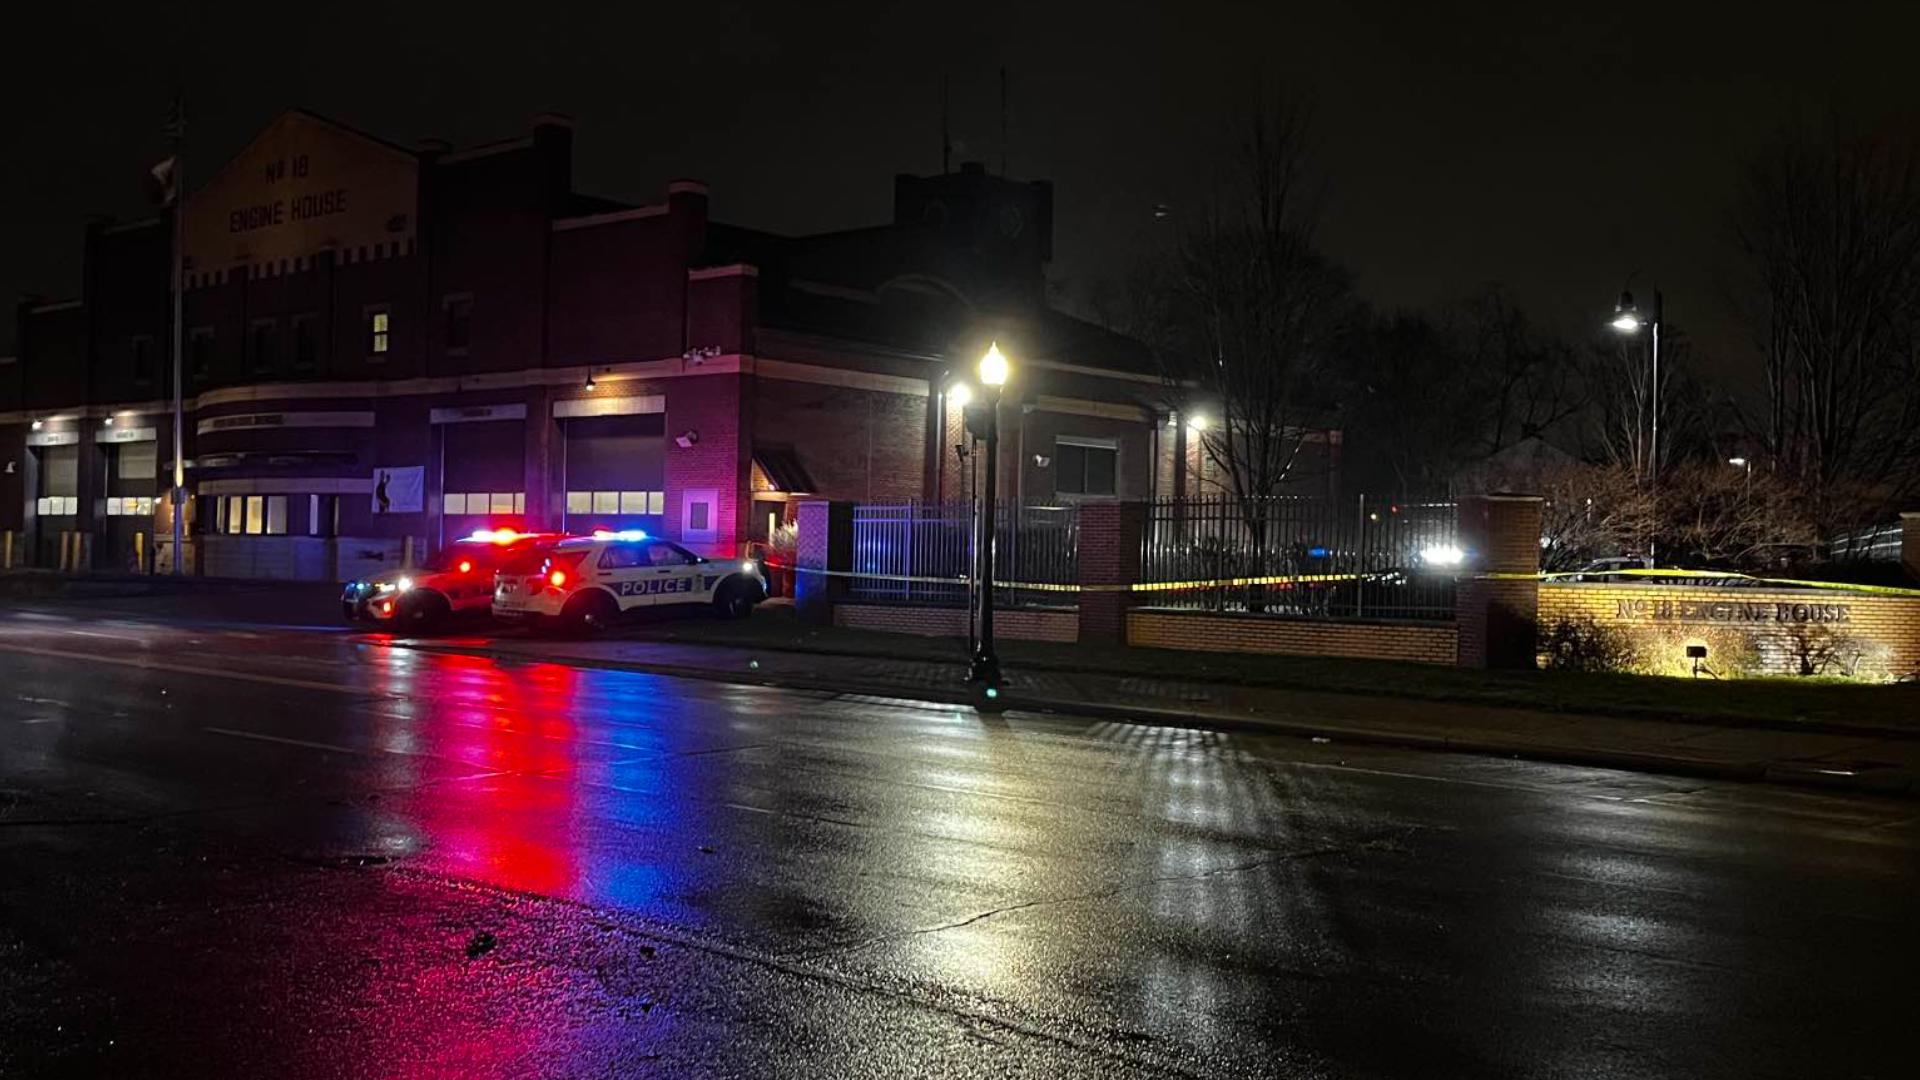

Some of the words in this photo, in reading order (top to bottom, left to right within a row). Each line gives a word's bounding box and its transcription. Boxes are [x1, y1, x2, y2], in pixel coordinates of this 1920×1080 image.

[292, 154, 309, 179] 18
[229, 201, 284, 234] ENGINE
[291, 189, 348, 221] HOUSE
[621, 578, 687, 597] POLICE
[1653, 600, 1674, 621] 18
[1681, 601, 1771, 623] ENGINE
[1776, 603, 1850, 624] HOUSE
